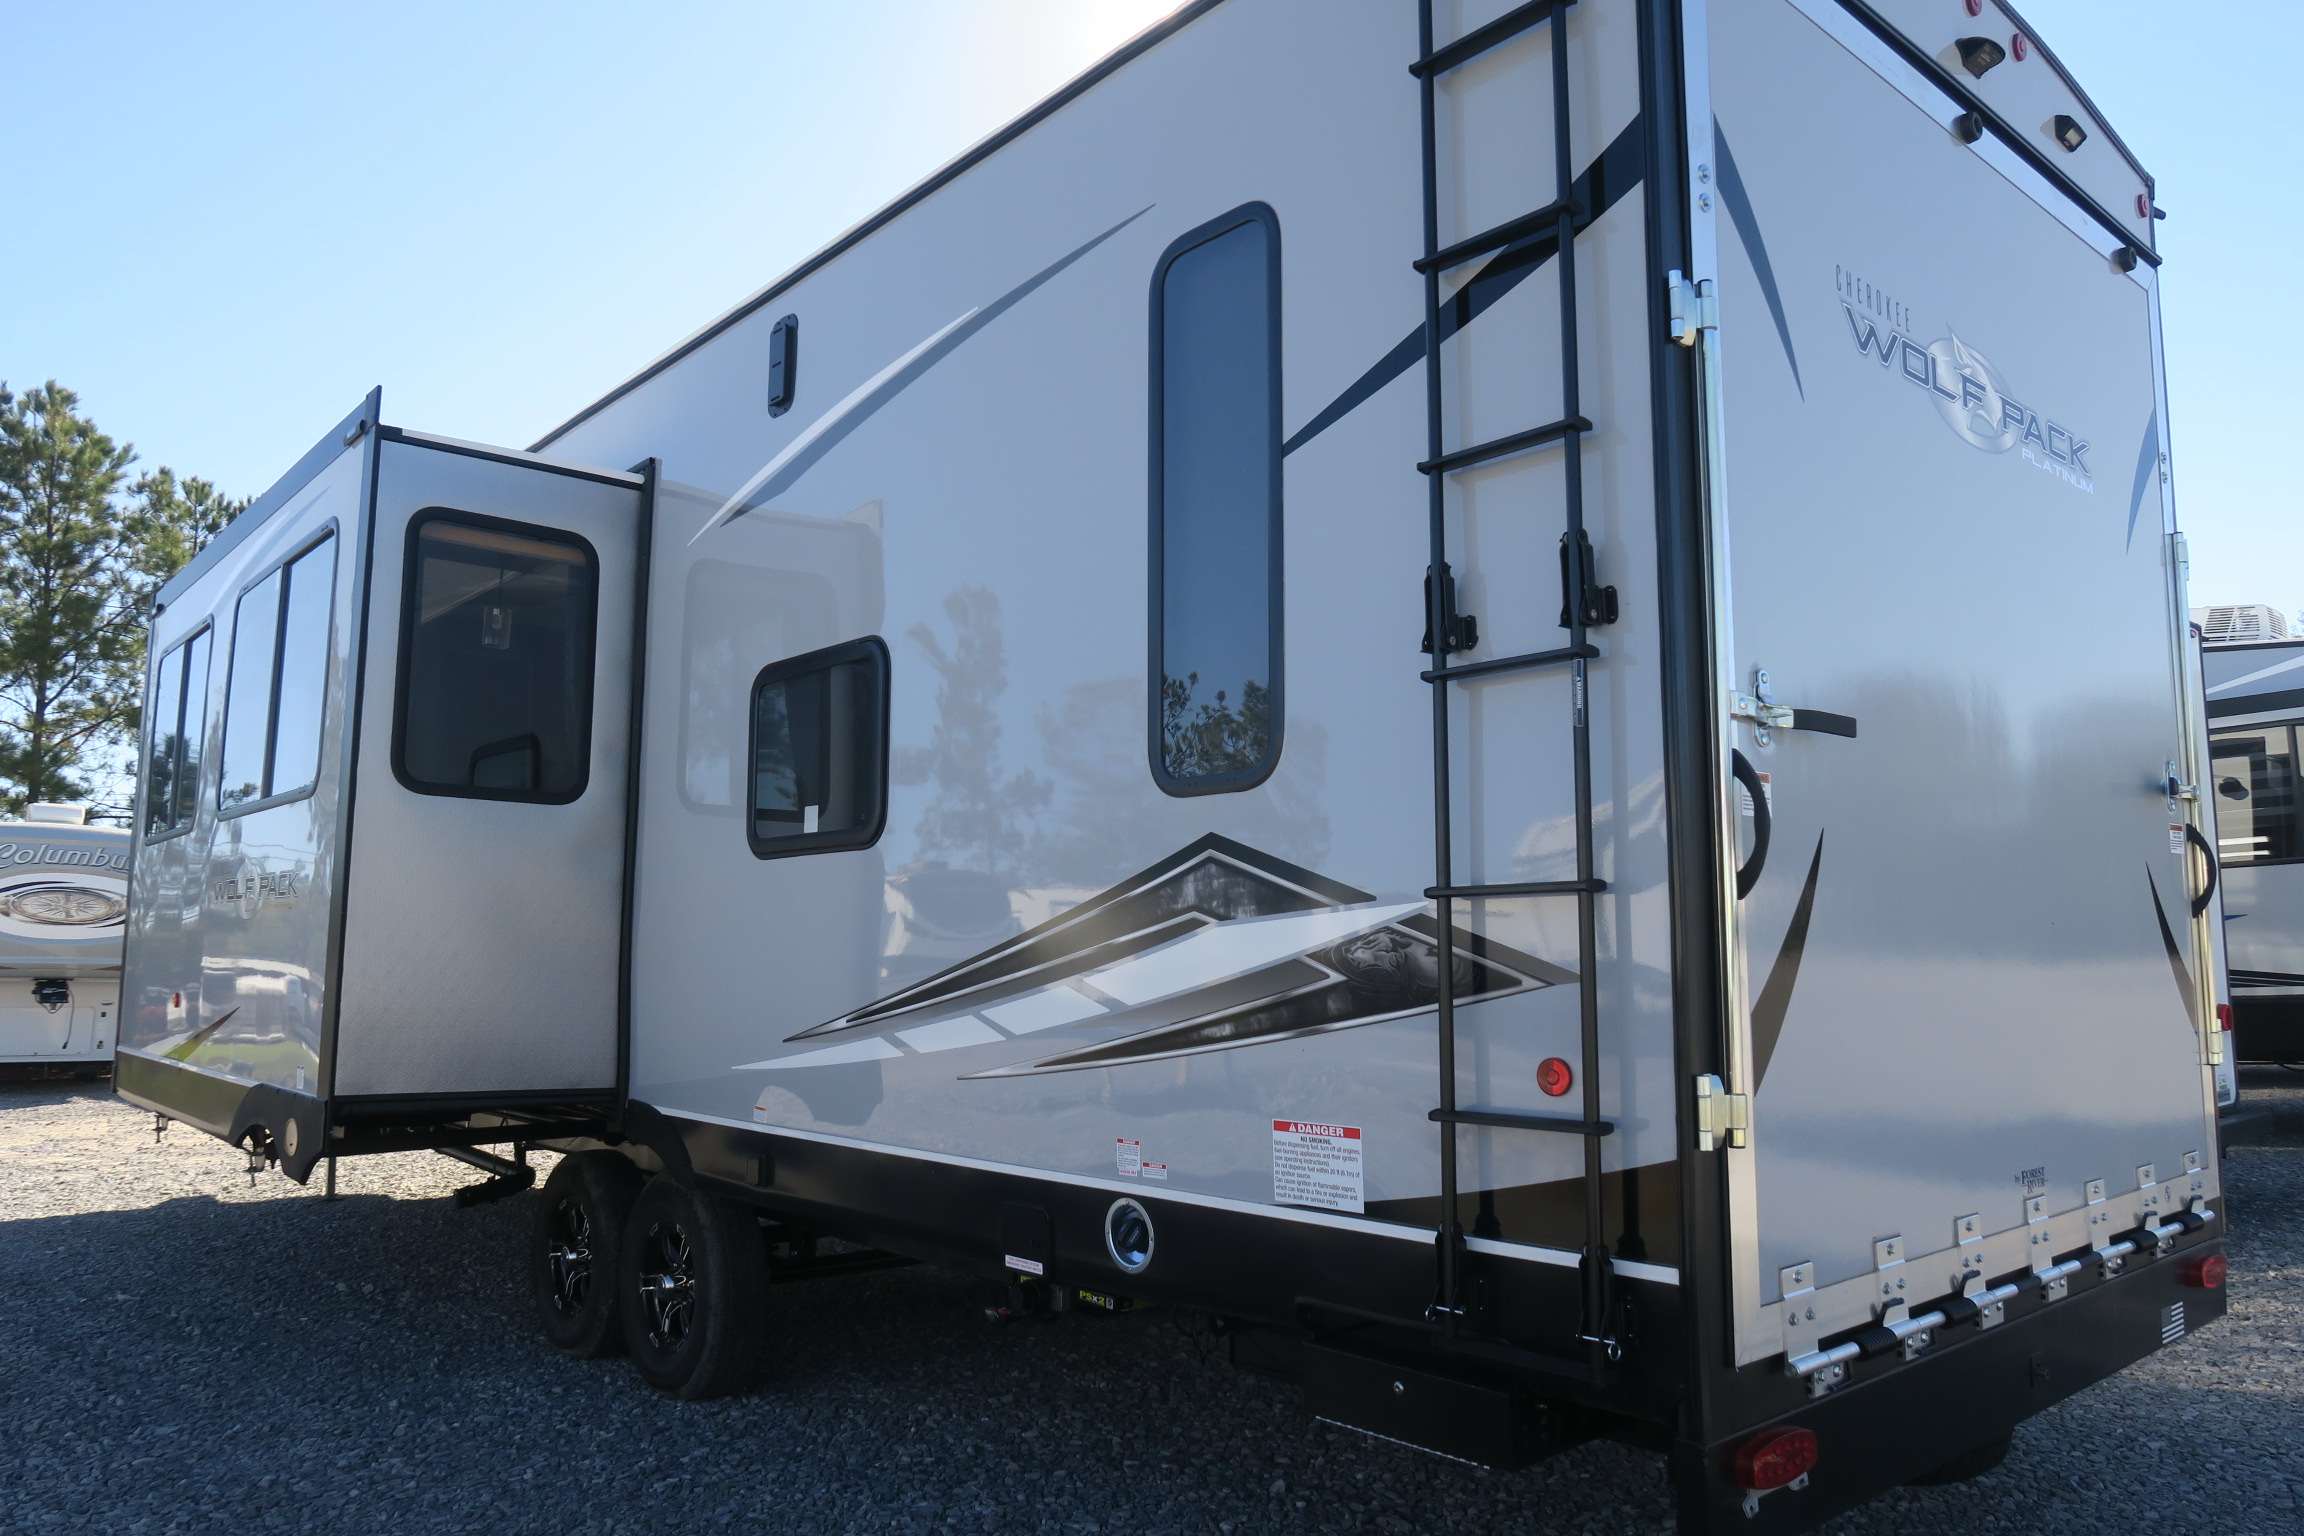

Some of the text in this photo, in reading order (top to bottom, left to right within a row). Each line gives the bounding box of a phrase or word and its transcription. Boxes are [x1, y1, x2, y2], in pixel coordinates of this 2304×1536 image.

[1835, 264, 1910, 333] CHEROKEE
[1840, 299, 2092, 478] WOLF PACK
[2021, 447, 2094, 494] PLATINUM
[0, 842, 130, 870] Columbu
[213, 875, 256, 903] WOLF
[258, 869, 301, 899] PACK
[1298, 1124, 1344, 1136] DANGER
[1288, 1141, 1309, 1150] dispensing
[1309, 1137, 1332, 1145] SMOKING.
[1274, 1147, 1298, 1155] fuel-burning
[1300, 1150, 1321, 1158] appliances
[1284, 1156, 1302, 1164] operating
[1288, 1164, 1306, 1172] dispense
[2021, 1167, 2045, 1184] FOREST
[1318, 1182, 1340, 1190] flammable
[2026, 1178, 2045, 1194] RIVER
[1329, 1191, 1348, 1200] explosion
[1079, 1290, 1105, 1306] PSx2
